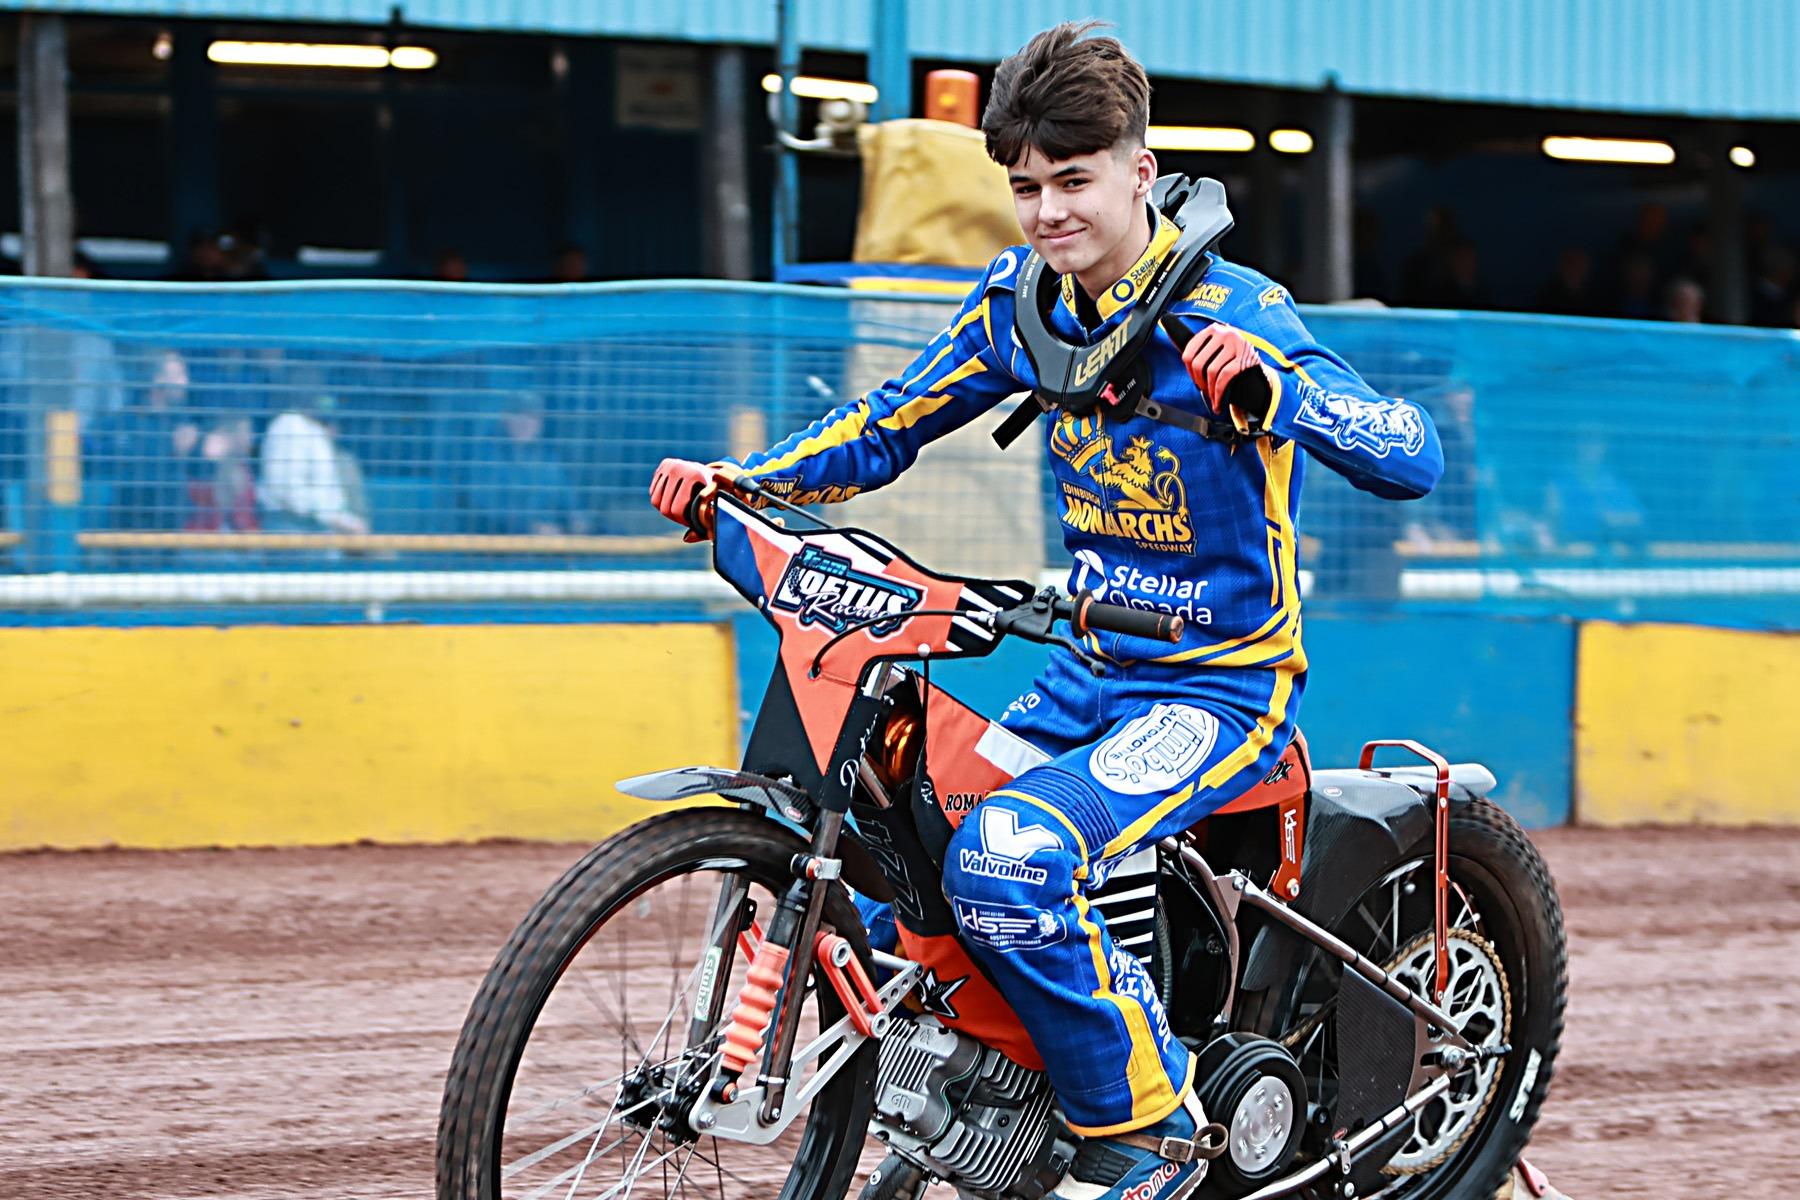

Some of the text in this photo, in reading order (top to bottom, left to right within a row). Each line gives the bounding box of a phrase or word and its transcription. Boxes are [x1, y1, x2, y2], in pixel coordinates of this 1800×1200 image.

[1130, 255, 1157, 280] Stellar
[1135, 262, 1160, 288] Omada
[1074, 313, 1133, 387] LEATT
[1062, 483, 1100, 504] EDINBURGH
[1062, 495, 1192, 543] MONARCHS
[1135, 540, 1193, 554] SPEEDWAY
[777, 566, 909, 618] LOFTUS
[1110, 565, 1208, 600] Stellar
[1098, 707, 1206, 784] Jimbo's
[1110, 709, 1177, 760] AUTOMOTIVE
[944, 792, 990, 811] ROMA
[960, 850, 1047, 883] Valvoline
